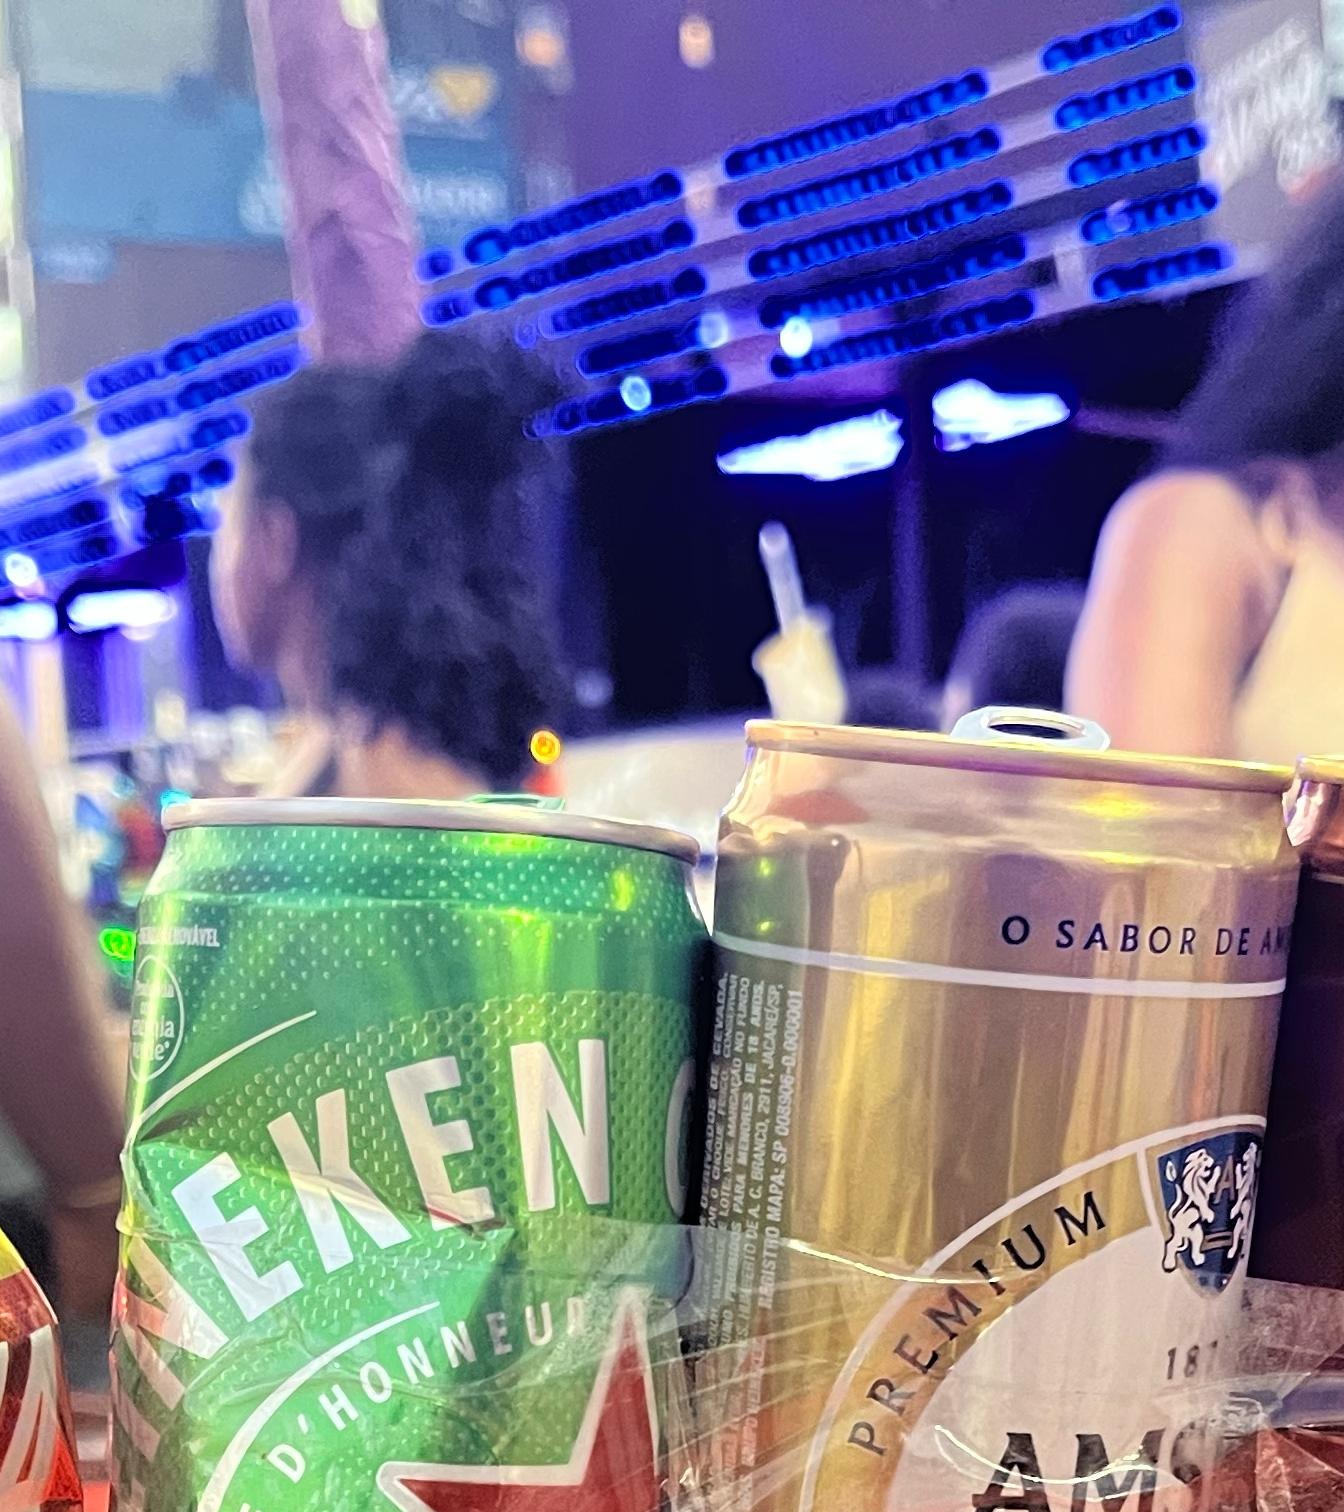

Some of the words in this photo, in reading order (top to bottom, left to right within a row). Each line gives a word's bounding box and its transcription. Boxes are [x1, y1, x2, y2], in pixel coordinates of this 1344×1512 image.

[1002, 915, 1030, 945] O
[1056, 919, 1196, 955] SABOR
[1215, 926, 1250, 956] DE
[710, 970, 729, 1055] CEVADA.
[734, 975, 751, 1026] FUNDO
[749, 978, 765, 1027] ANOS.
[732, 1030, 745, 1052] NO
[746, 1034, 759, 1054] 18
[757, 982, 784, 1070] JACAREÍ/SP,
[743, 1061, 757, 1084] DE
[735, 1091, 755, 1165] MENORES
[749, 1117, 770, 1181] BRANCO,
[770, 1138, 790, 1164] SP
[731, 1173, 746, 1214] PARA
[764, 1166, 787, 1222] MAPA:
[744, 1219, 759, 1239] DE
[756, 1224, 780, 1309] REGISTRO
[847, 1190, 1108, 1458] PREMIUM
